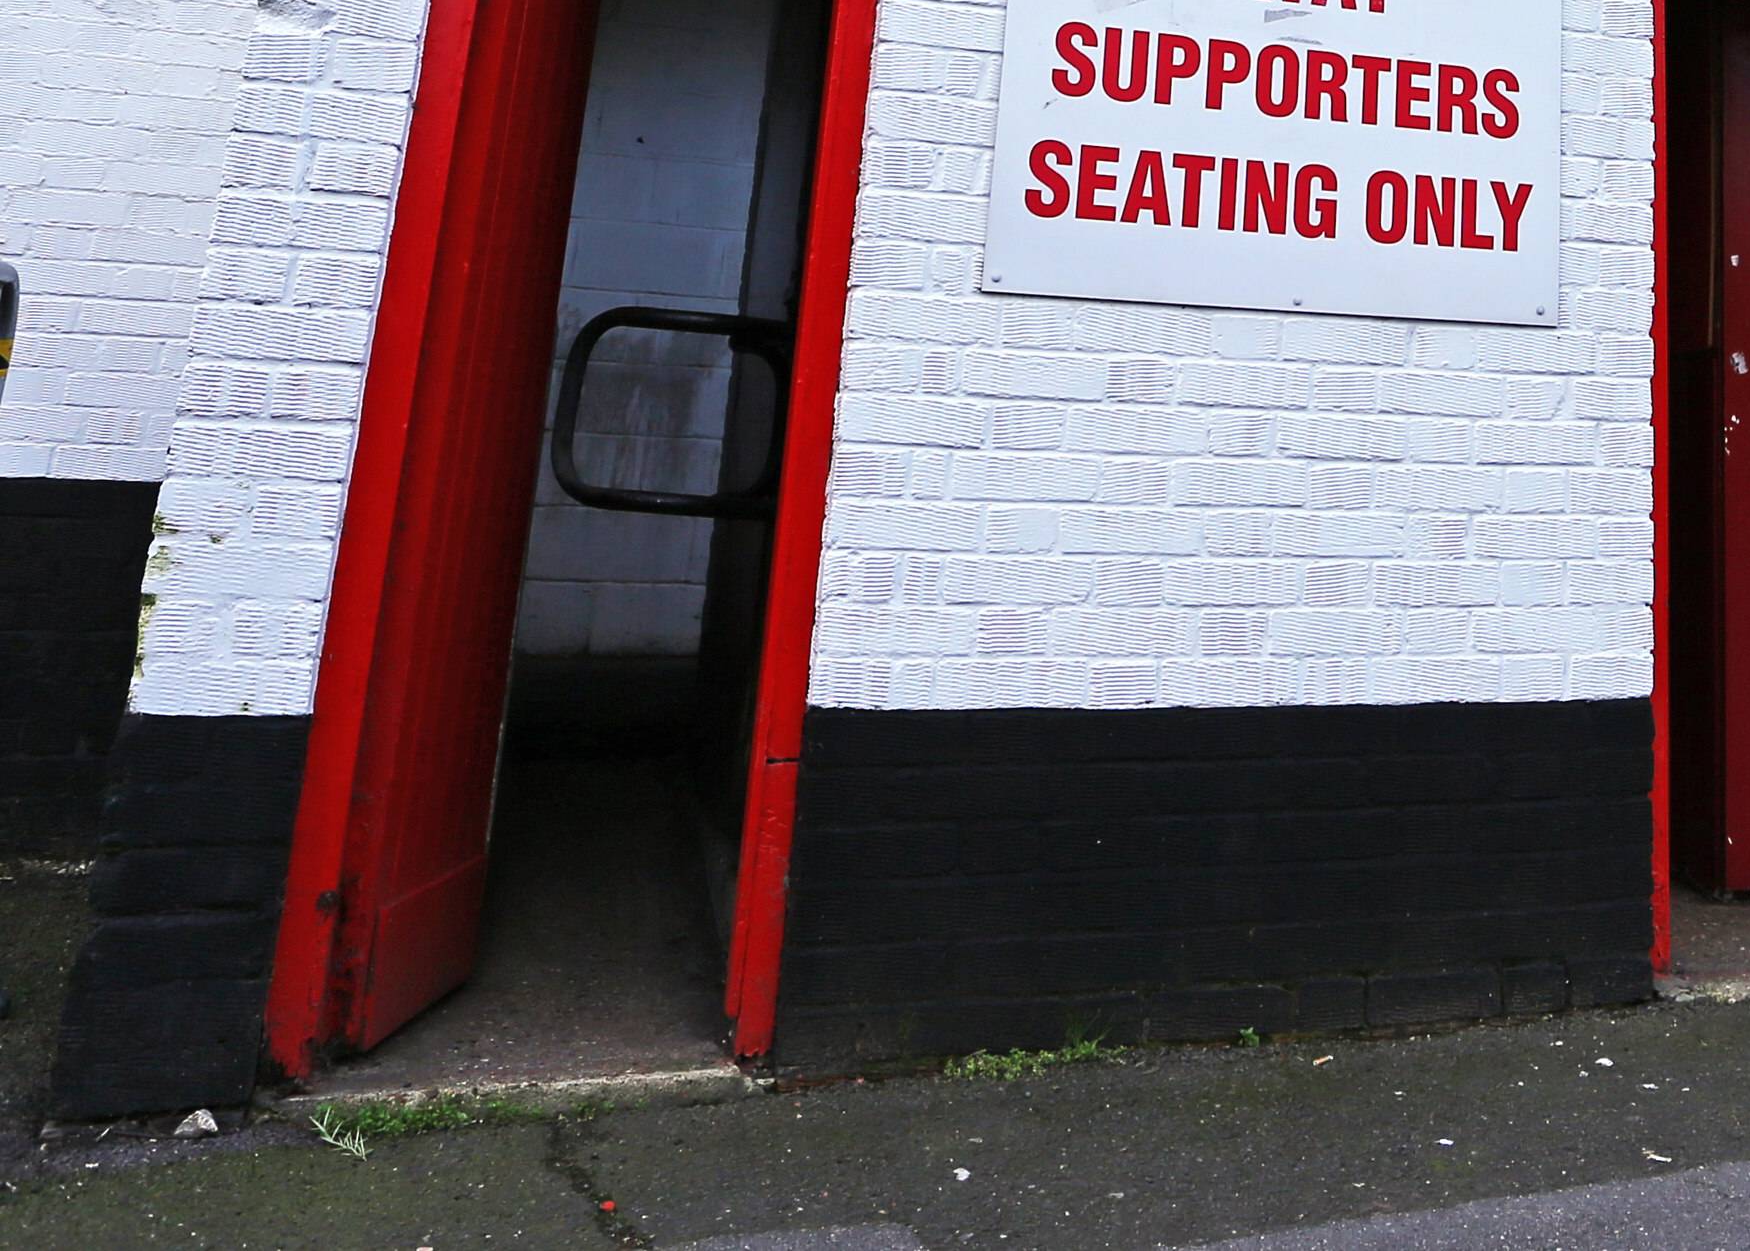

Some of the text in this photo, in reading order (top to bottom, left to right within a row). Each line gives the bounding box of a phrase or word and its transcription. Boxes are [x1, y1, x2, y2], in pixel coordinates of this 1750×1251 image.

[1051, 21, 1521, 140] SUPPORTERS
[1024, 139, 1533, 253] SEATING ONLY
